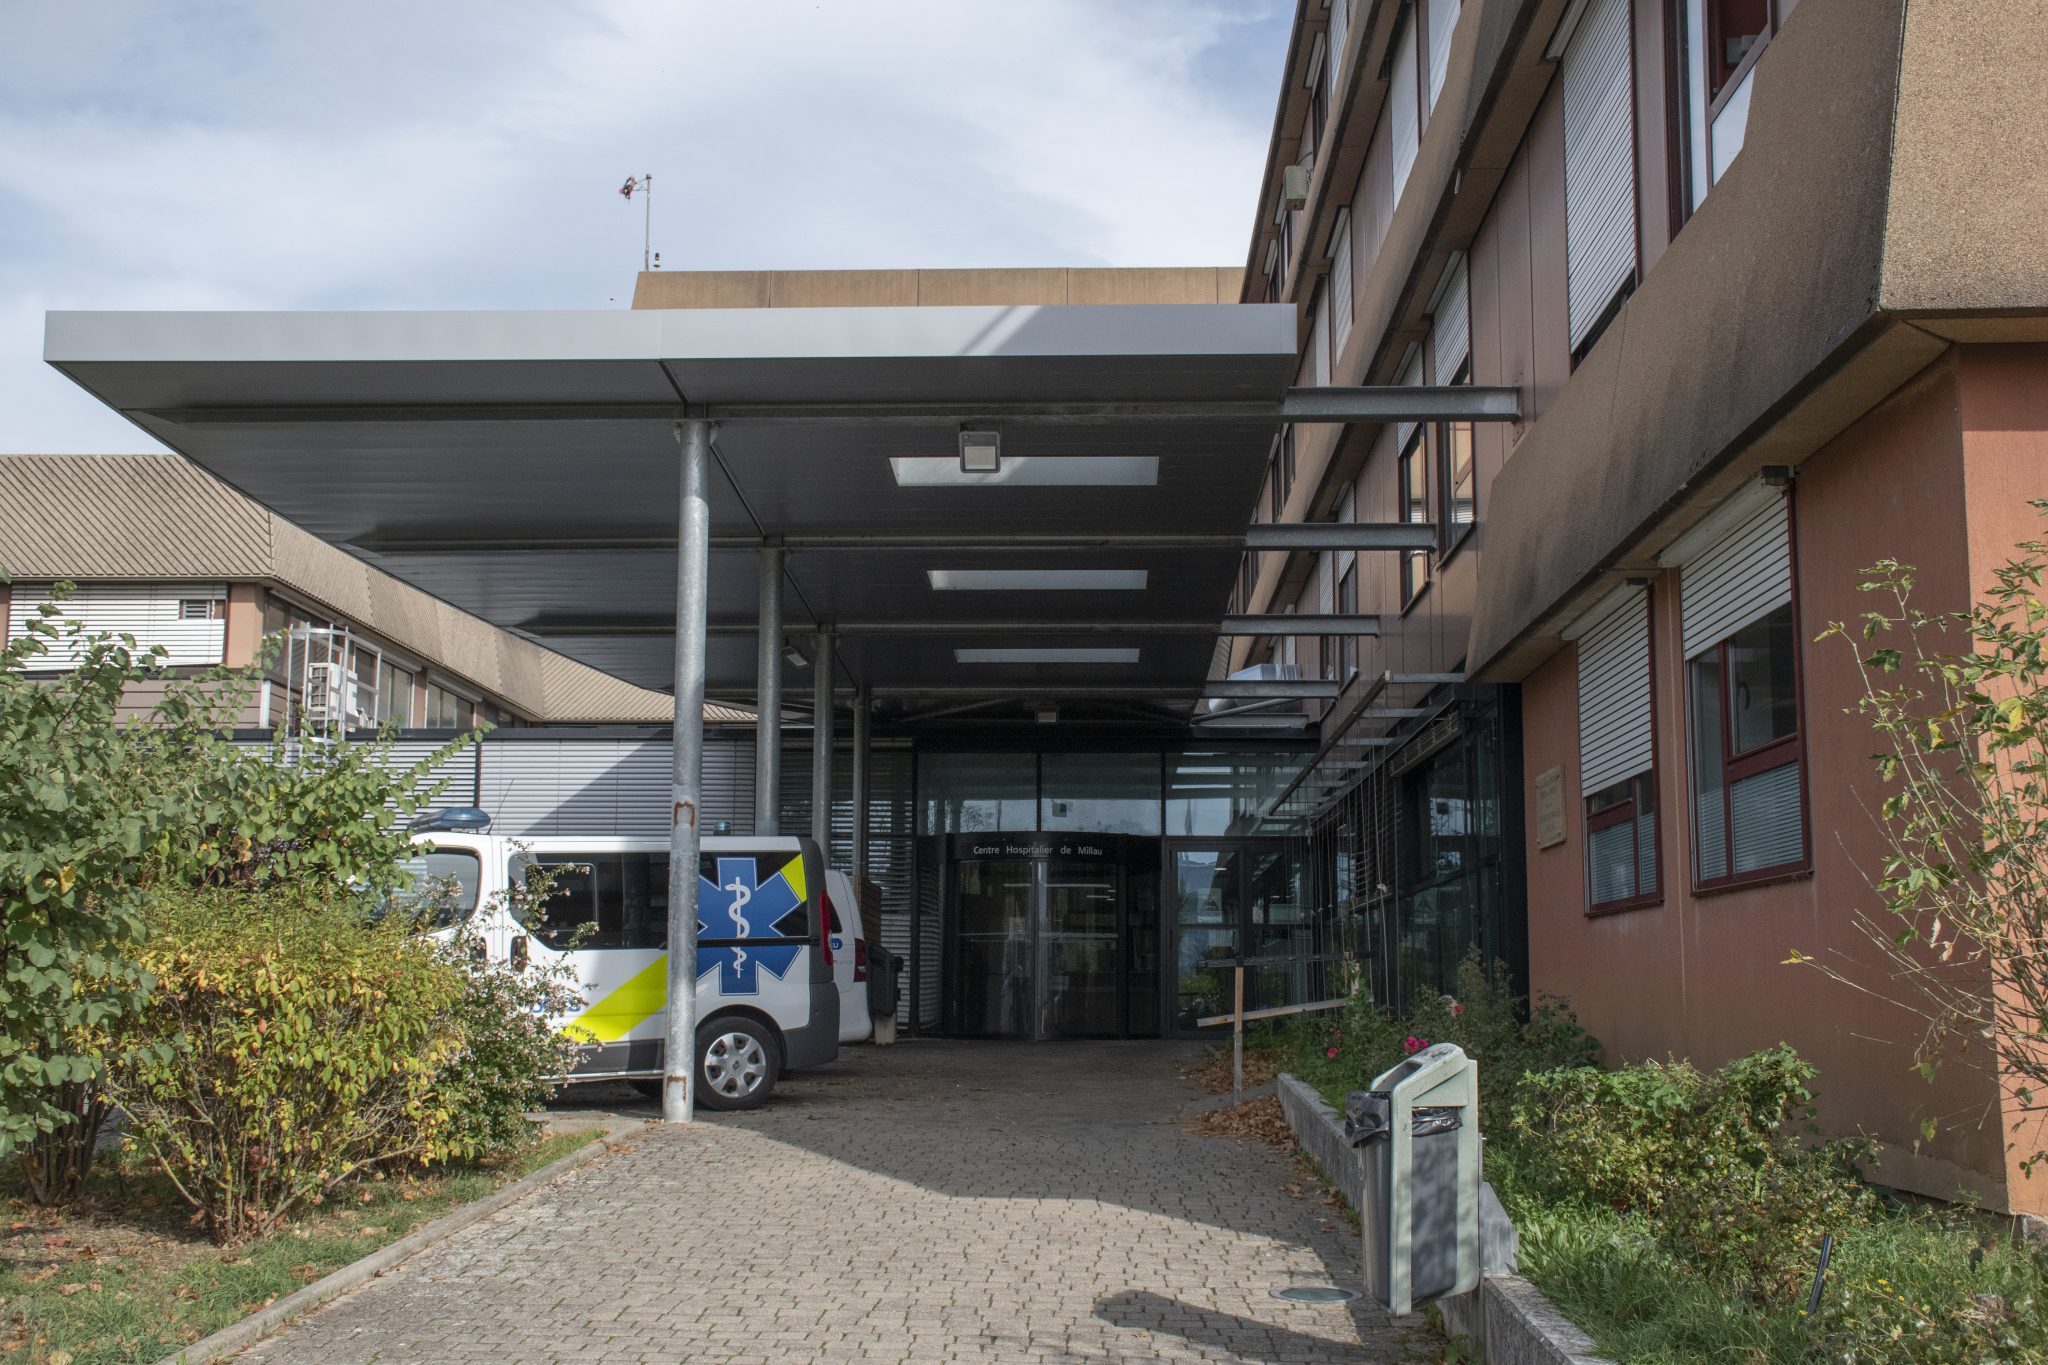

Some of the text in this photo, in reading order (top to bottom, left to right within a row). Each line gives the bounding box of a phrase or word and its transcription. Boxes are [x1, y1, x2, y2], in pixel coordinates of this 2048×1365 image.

[974, 845, 1102, 856] Centre Hospitalier de Millau
